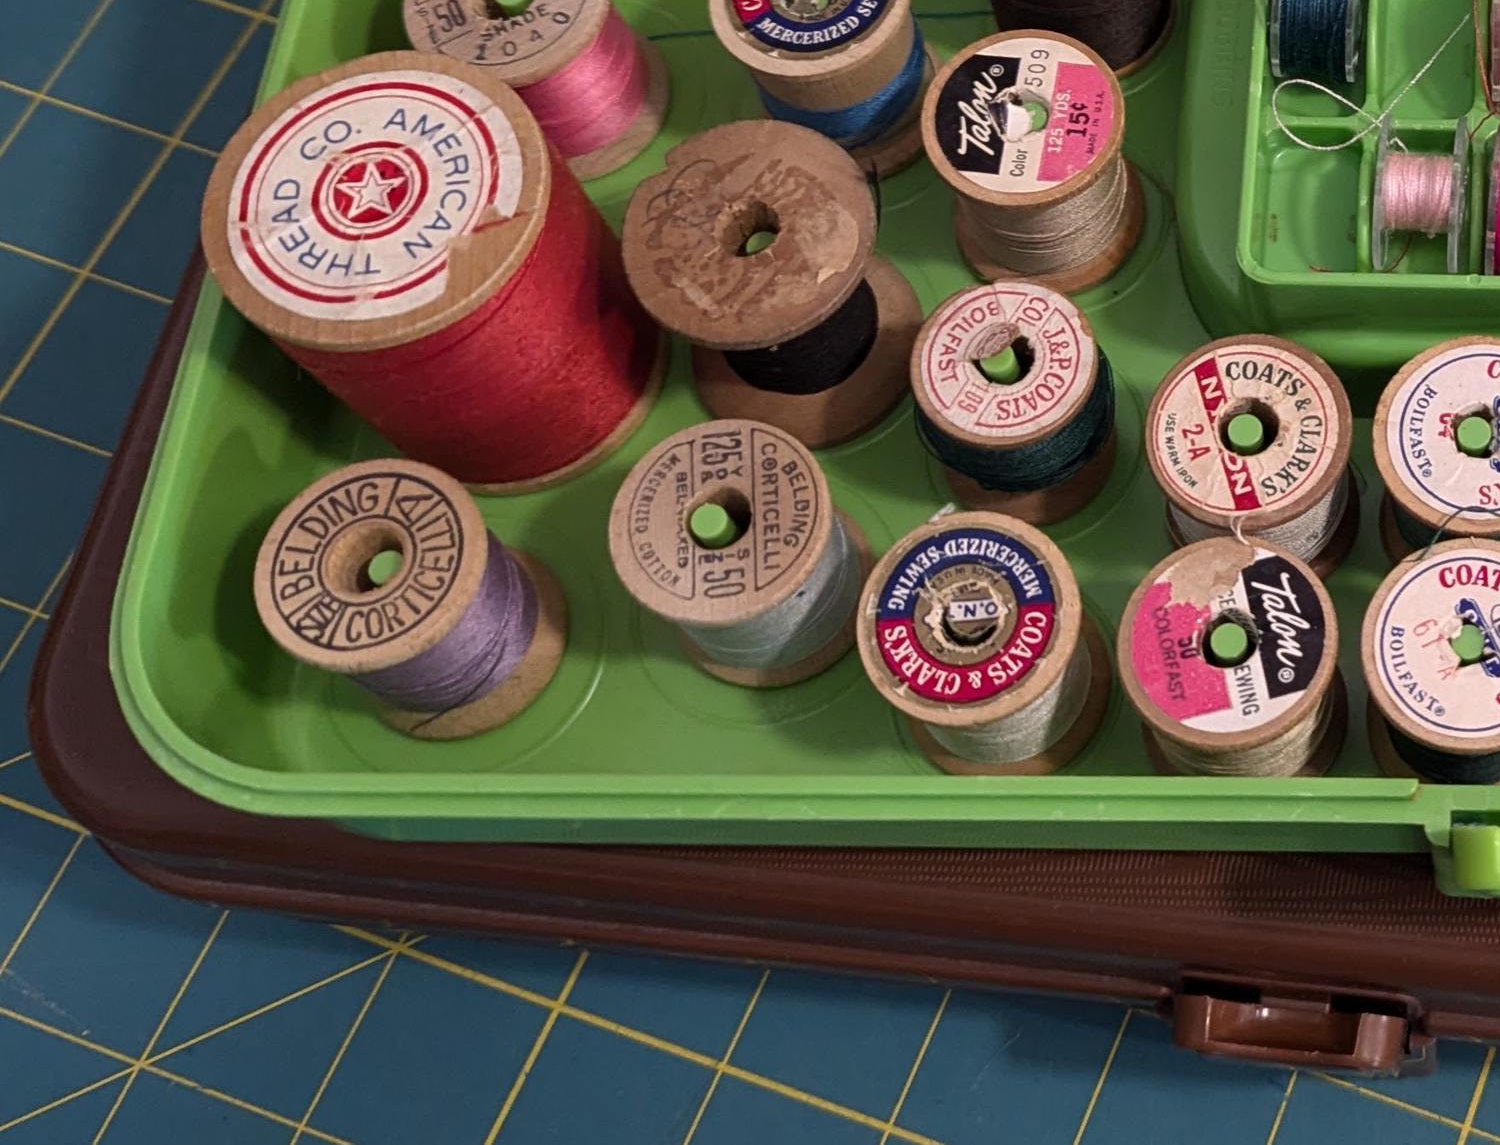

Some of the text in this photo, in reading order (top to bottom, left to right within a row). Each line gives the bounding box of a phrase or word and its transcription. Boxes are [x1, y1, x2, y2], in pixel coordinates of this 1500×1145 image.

[480, 3, 550, 43] SHADE
[755, 15, 861, 45] MERCERIZED
[957, 71, 998, 156] Talon
[1009, 48, 1050, 177] Color 509
[1047, 127, 1065, 153] 125
[1066, 103, 1090, 137] 15¢
[1083, 117, 1100, 155] MADE IN
[271, 107, 470, 277] AMERICAN THREAD CO.
[938, 301, 1000, 382] BOILFAST
[996, 372, 1065, 421] COATS
[1201, 376, 1251, 496] NYON
[1225, 361, 1324, 498] COATS CLARK'S
[1164, 413, 1181, 468] USE WARM
[1181, 423, 1212, 461] 2-A
[279, 482, 380, 601] BELDING
[634, 453, 681, 587] MERCERIZED COTTON
[760, 442, 781, 570] CORTICELLI
[781, 460, 811, 549] BELDING
[702, 567, 746, 599] 50
[887, 538, 1043, 611] MERCERIZED SEWING
[883, 610, 1047, 695] COATS CLARK'S
[1152, 603, 1186, 701] COLORFAST
[1251, 571, 1311, 668] Talon
[1233, 664, 1261, 716] EWING
